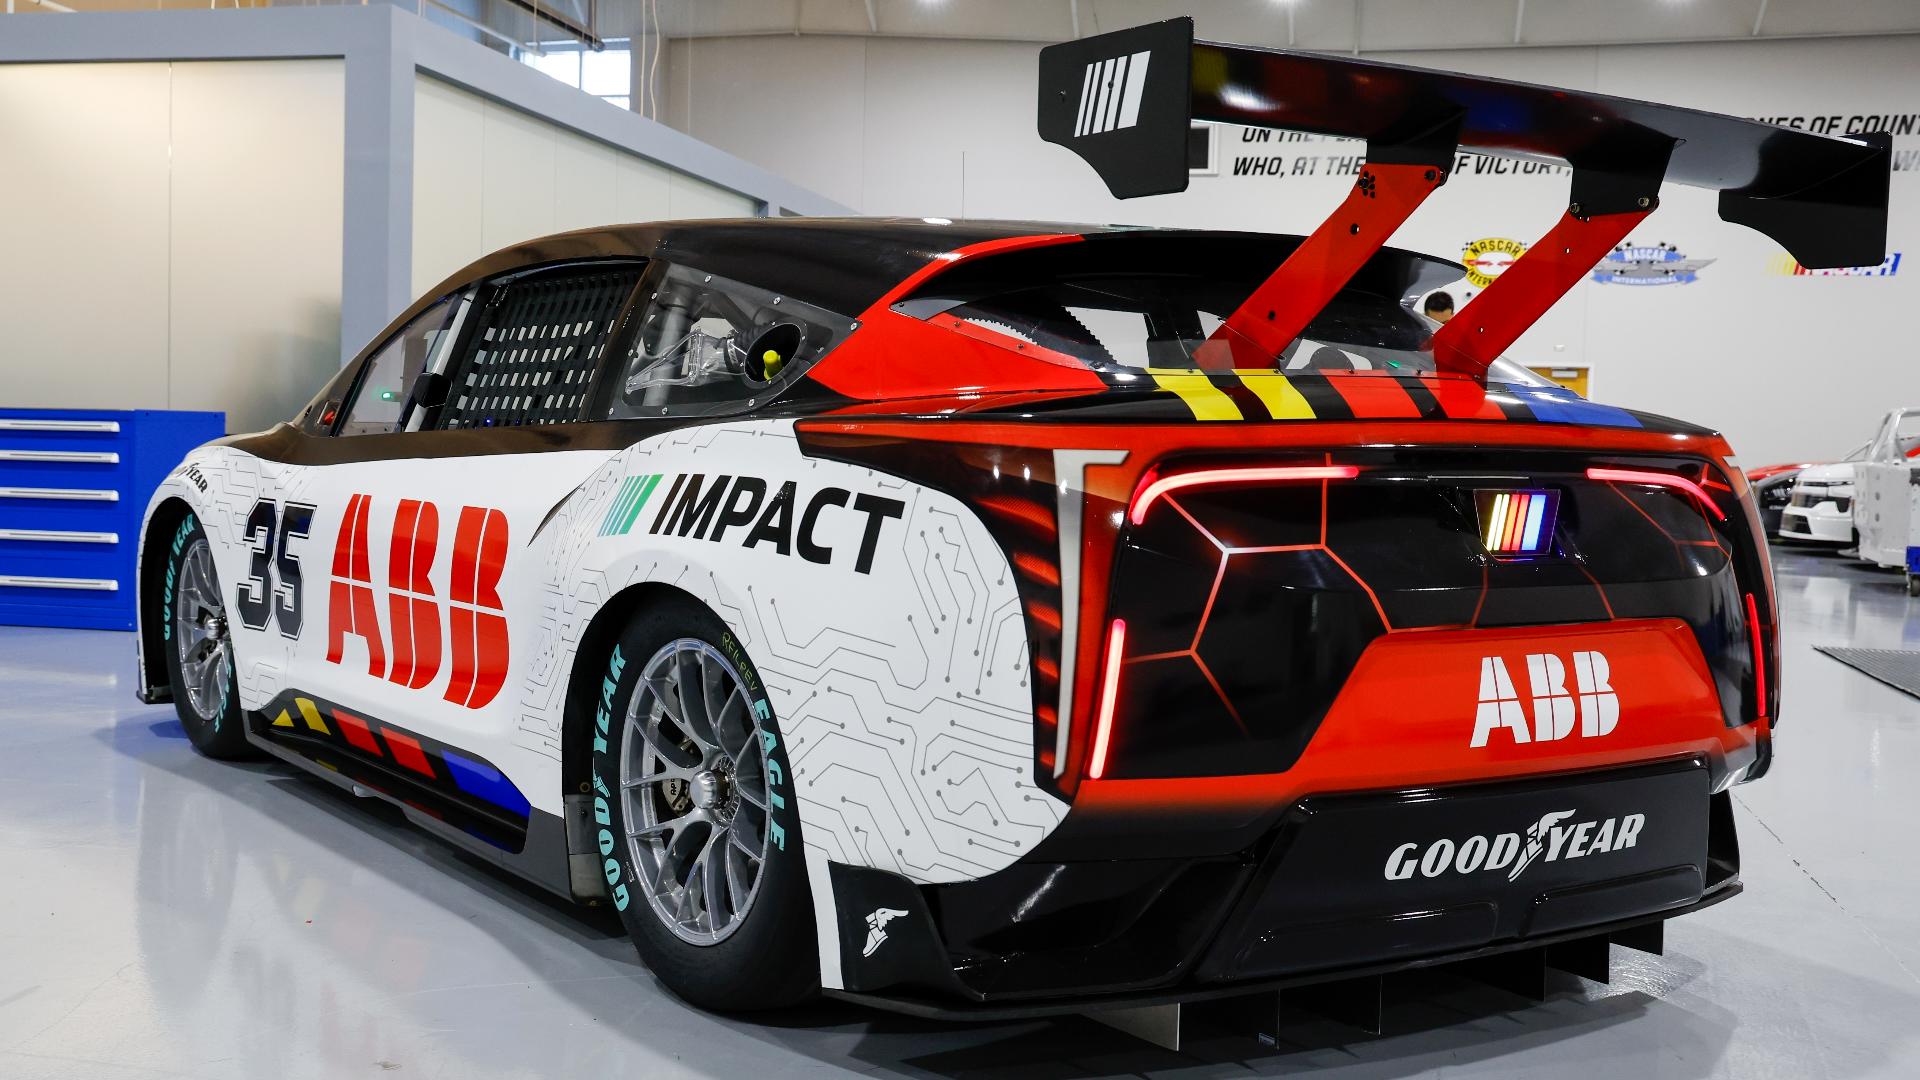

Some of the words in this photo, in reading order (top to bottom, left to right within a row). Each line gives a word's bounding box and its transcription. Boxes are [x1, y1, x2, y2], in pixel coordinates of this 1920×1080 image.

[1233, 157, 1285, 178] WHO,
[1291, 157, 1317, 175] AT
[1326, 157, 1366, 175] THE
[1809, 115, 1842, 135] OF
[1845, 114, 1920, 136] COUN
[1470, 240, 1521, 257] NASCAR
[1624, 246, 1667, 262] NASCAR
[235, 497, 318, 641] 35
[649, 473, 905, 575] IMPACT
[326, 493, 510, 709] ABB
[1470, 651, 1620, 748] ABB
[754, 698, 785, 852] EAGLE
